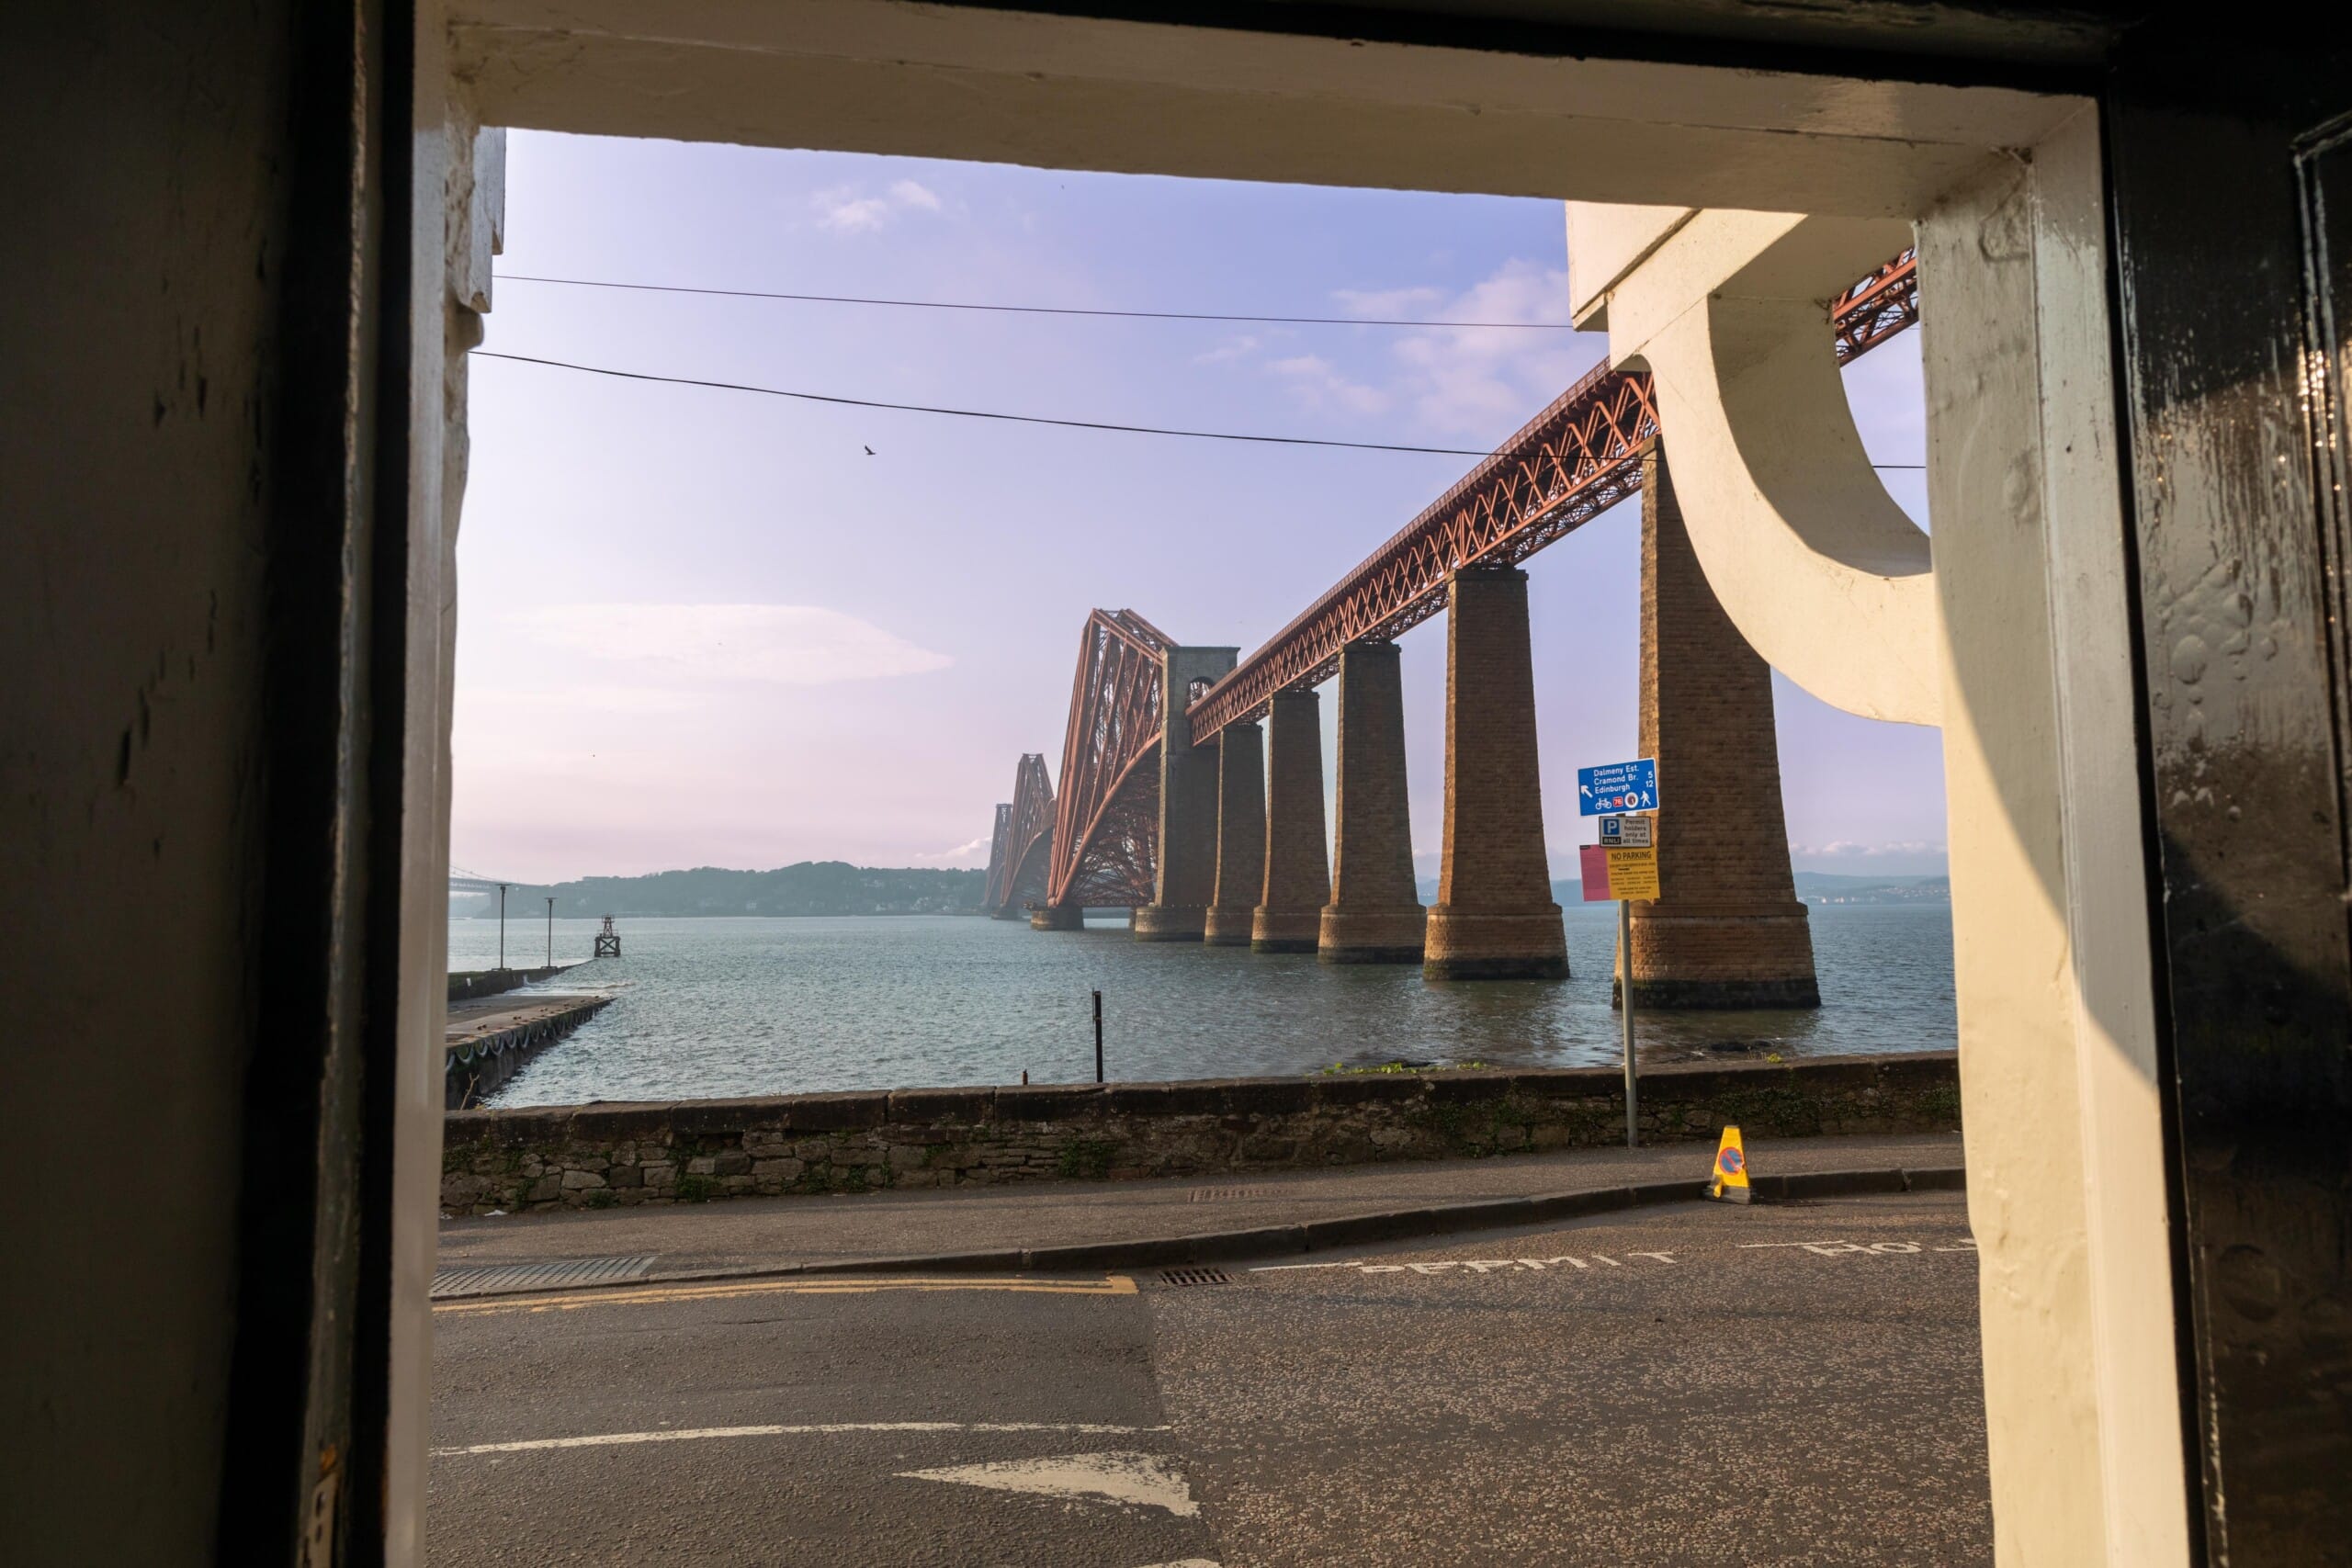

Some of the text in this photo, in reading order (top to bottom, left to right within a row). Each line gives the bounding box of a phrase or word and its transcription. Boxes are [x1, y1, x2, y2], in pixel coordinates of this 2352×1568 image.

[1593, 764, 1639, 777] Dalmeny Est.
[1647, 771, 1653, 779] 5
[1593, 775, 1625, 785] Cramond
[1594, 784, 1631, 794] Edinburgh
[1607, 820, 1617, 834] P
[1611, 851, 1652, 861] NO PARKING
[1357, 1251, 1679, 1274] PERMIT
